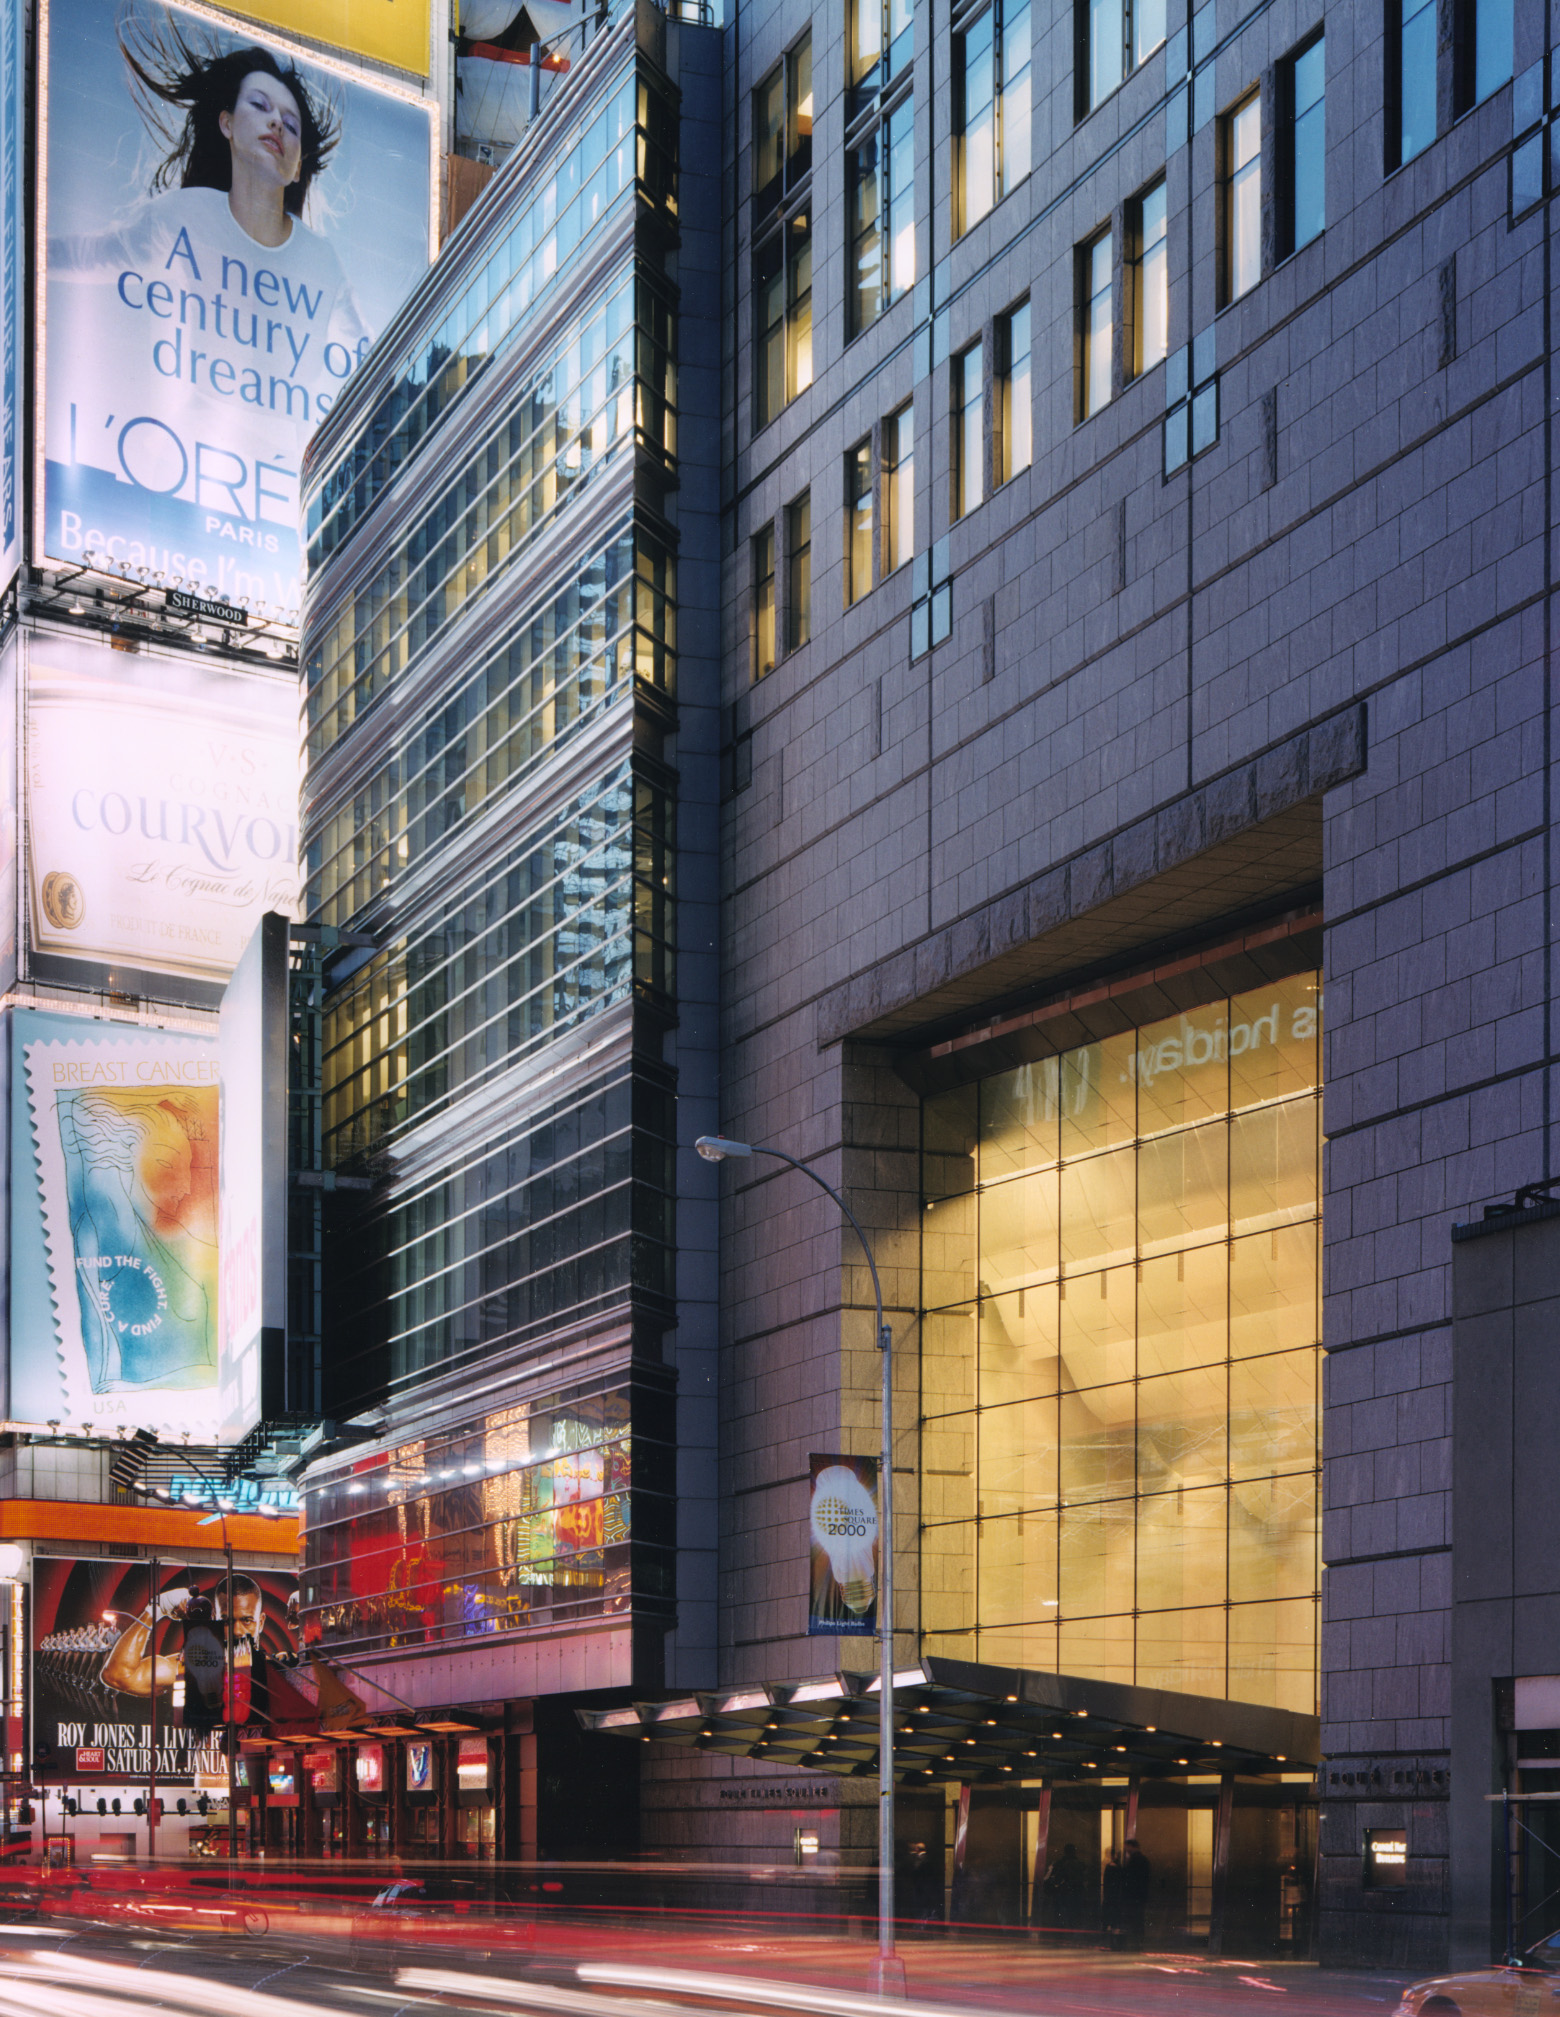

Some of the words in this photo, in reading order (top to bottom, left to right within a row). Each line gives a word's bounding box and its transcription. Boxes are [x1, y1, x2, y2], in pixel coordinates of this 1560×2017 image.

[4, 116, 14, 197] THE
[165, 226, 202, 281] A
[221, 255, 323, 320] new
[3, 215, 14, 376] FUTURE
[117, 270, 310, 378] century
[323, 336, 369, 379] of
[153, 327, 333, 427] dreams
[205, 516, 279, 553] PARIS
[60, 510, 208, 584] Because
[218, 555, 265, 598] I'm
[172, 592, 242, 622] SHERWOOD
[72, 788, 297, 872] COURVOI
[126, 859, 160, 884] Le
[160, 864, 230, 898] Cognac
[232, 880, 256, 898] de
[110, 913, 158, 938] PRODUIT
[159, 921, 177, 939] DE
[178, 924, 222, 946] FRANCE
[53, 1061, 128, 1083] BREAST
[136, 1059, 220, 1081] CANCER
[76, 1256, 113, 1269] FUND
[114, 1255, 142, 1270] THE
[101, 1280, 115, 1323] CURE.
[143, 1265, 168, 1311] FIGHT.
[117, 1320, 129, 1332] A
[131, 1313, 162, 1336] FIND
[93, 1400, 127, 1414] USA
[838, 1507, 864, 1516] TIMES
[844, 1516, 877, 1525] SQUARE
[828, 1523, 866, 1537] 2000
[57, 1722, 87, 1747] ROY
[91, 1723, 135, 1748] JONES
[163, 1725, 196, 1749] LIVE
